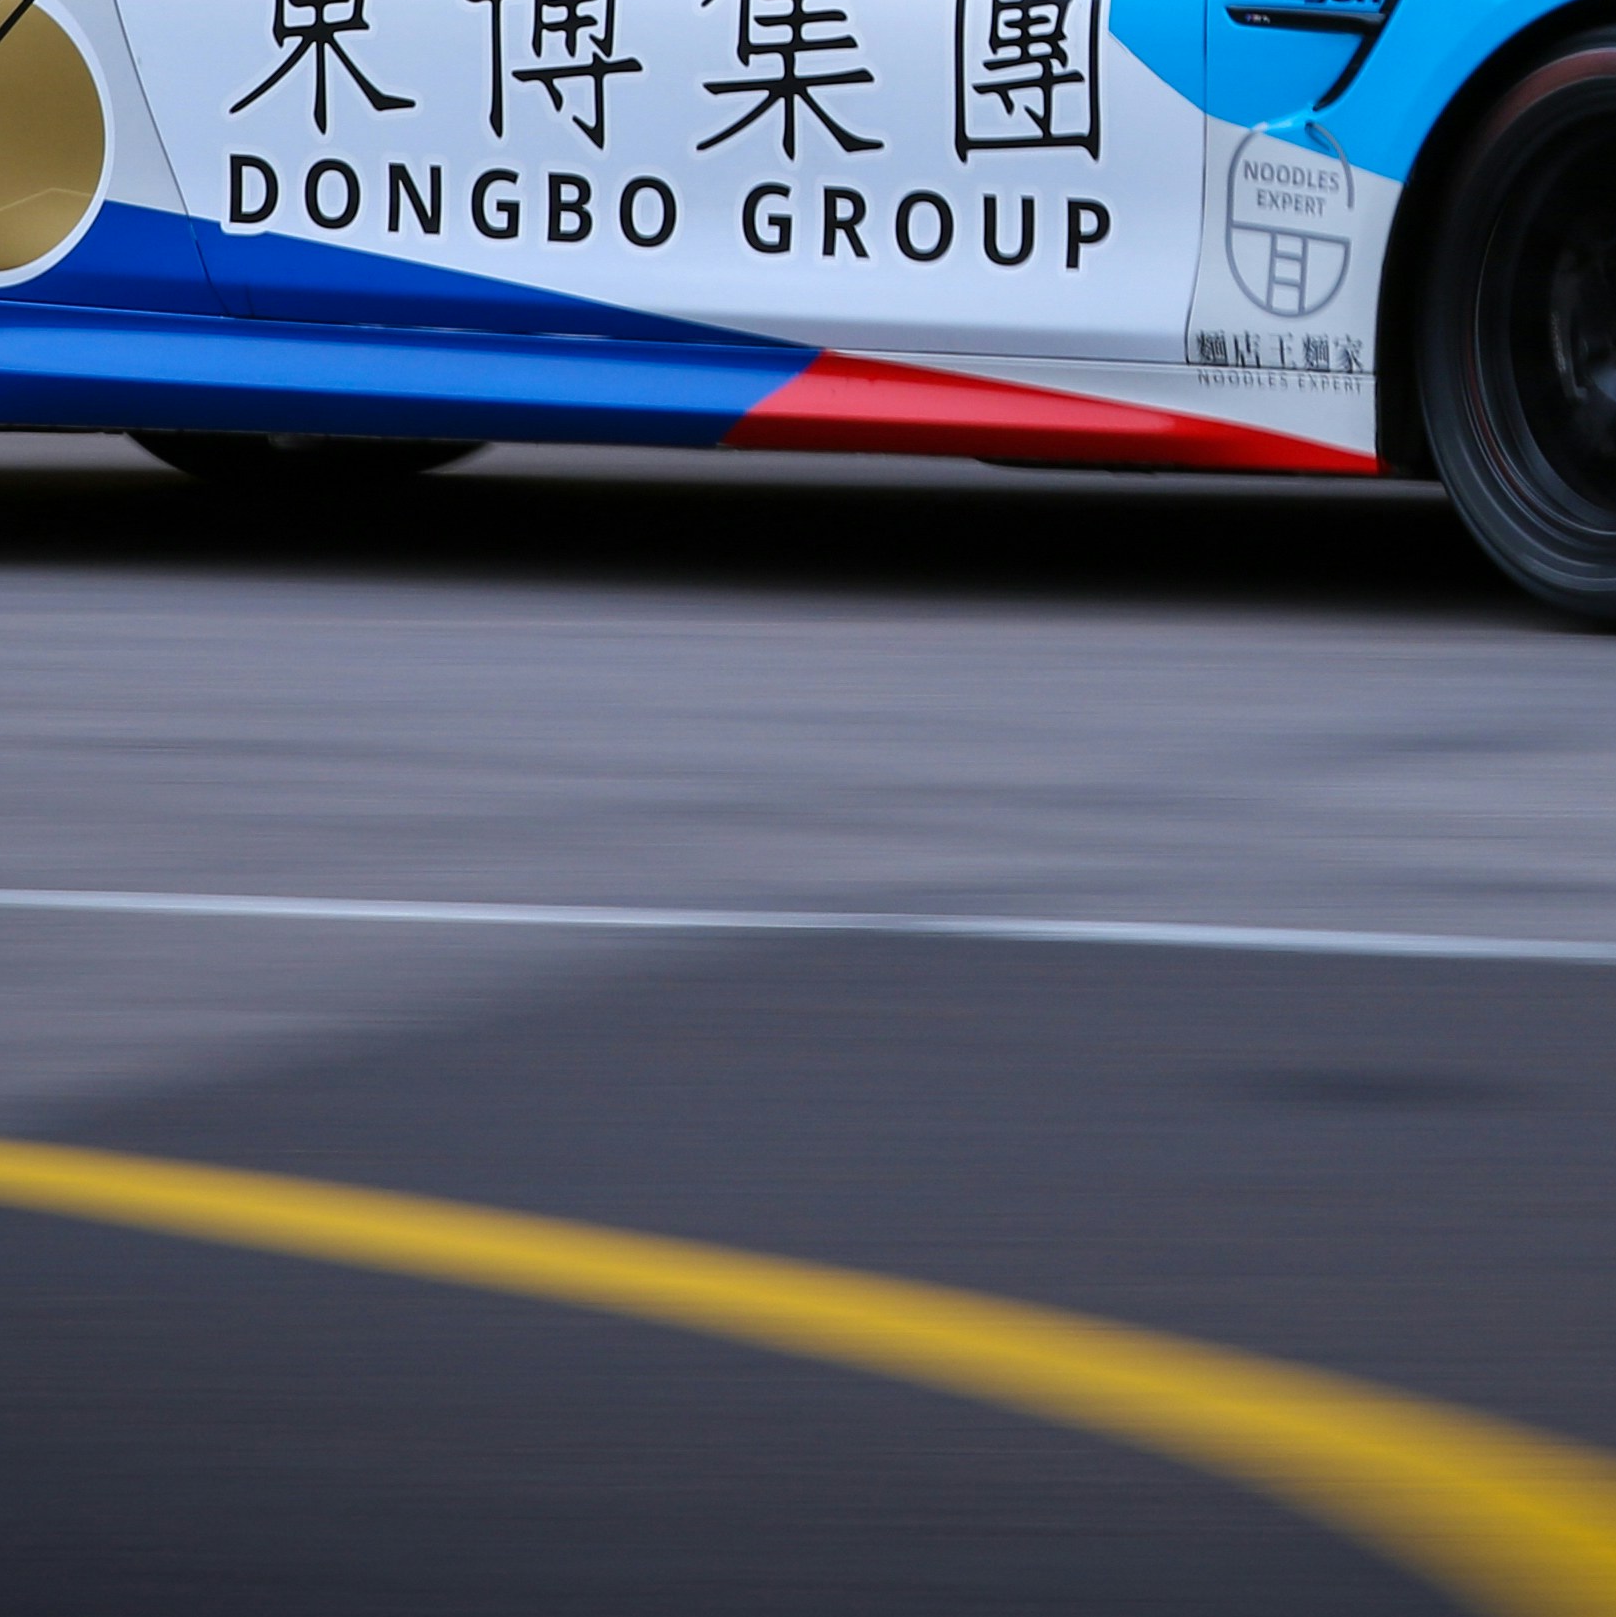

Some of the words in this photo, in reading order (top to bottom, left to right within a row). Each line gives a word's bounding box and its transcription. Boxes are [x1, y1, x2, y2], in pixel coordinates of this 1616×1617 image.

[1243, 159, 1341, 192] NOODLES
[229, 153, 677, 247] DONGBO
[742, 181, 1111, 270] GROUP
[1256, 188, 1326, 217] EXPERT
[1196, 368, 1289, 391] NOODLES
[1297, 372, 1363, 395] EXPERT
